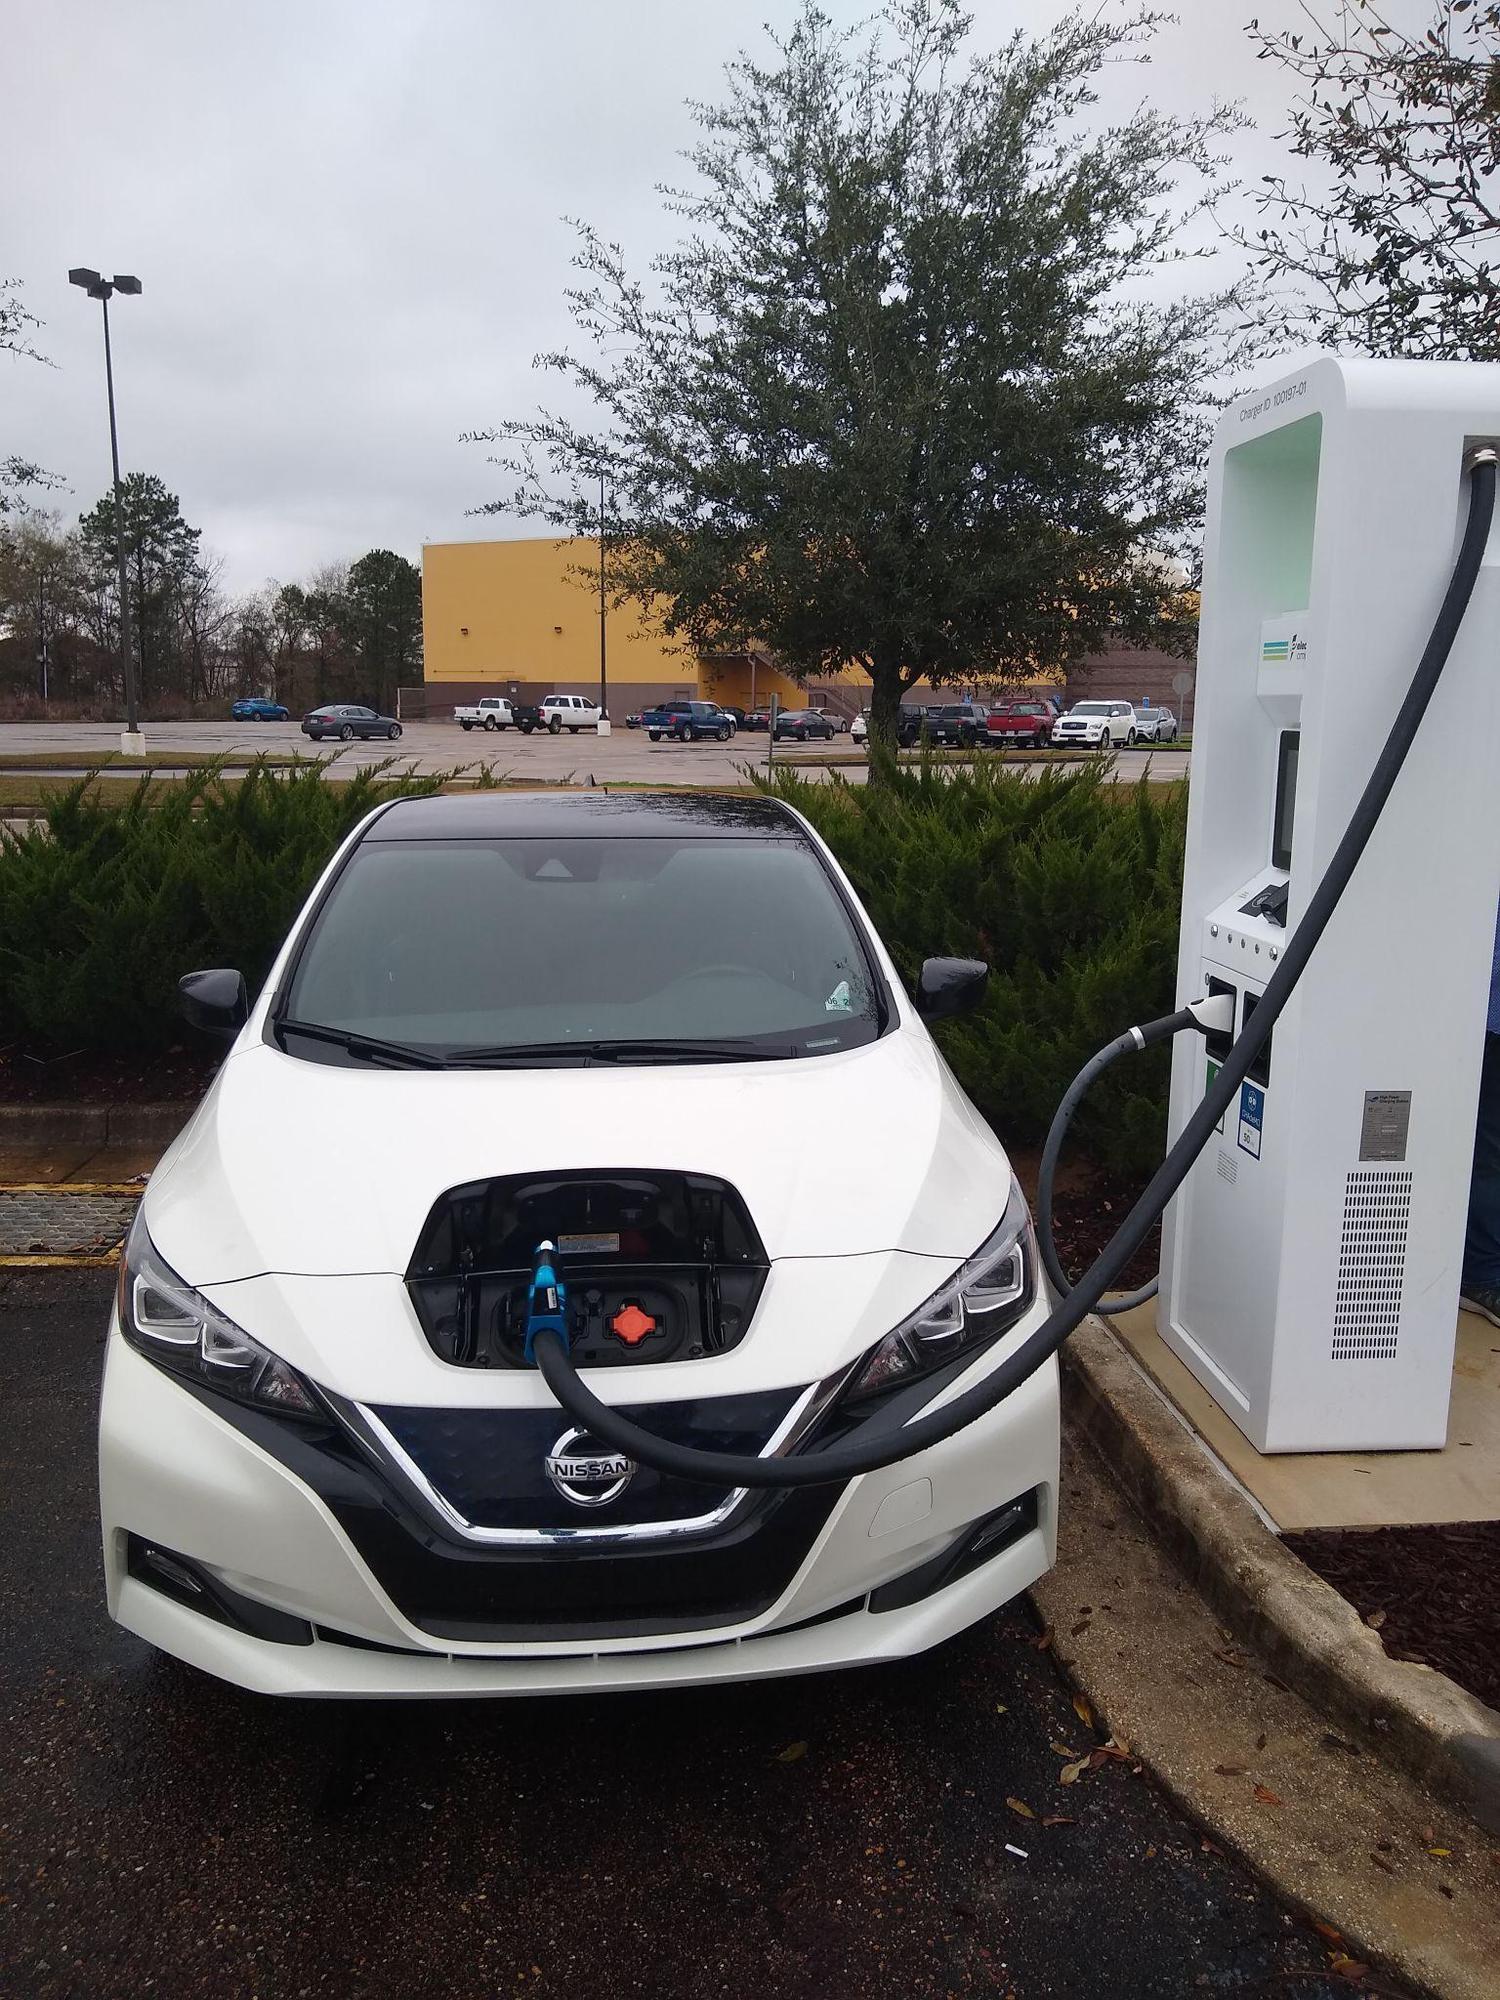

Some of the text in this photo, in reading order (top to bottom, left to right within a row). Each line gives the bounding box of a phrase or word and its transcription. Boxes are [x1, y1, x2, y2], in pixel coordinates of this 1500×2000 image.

[1240, 381, 1307, 422] Charger ID 100197-01
[554, 1461, 629, 1477] NISSAN
